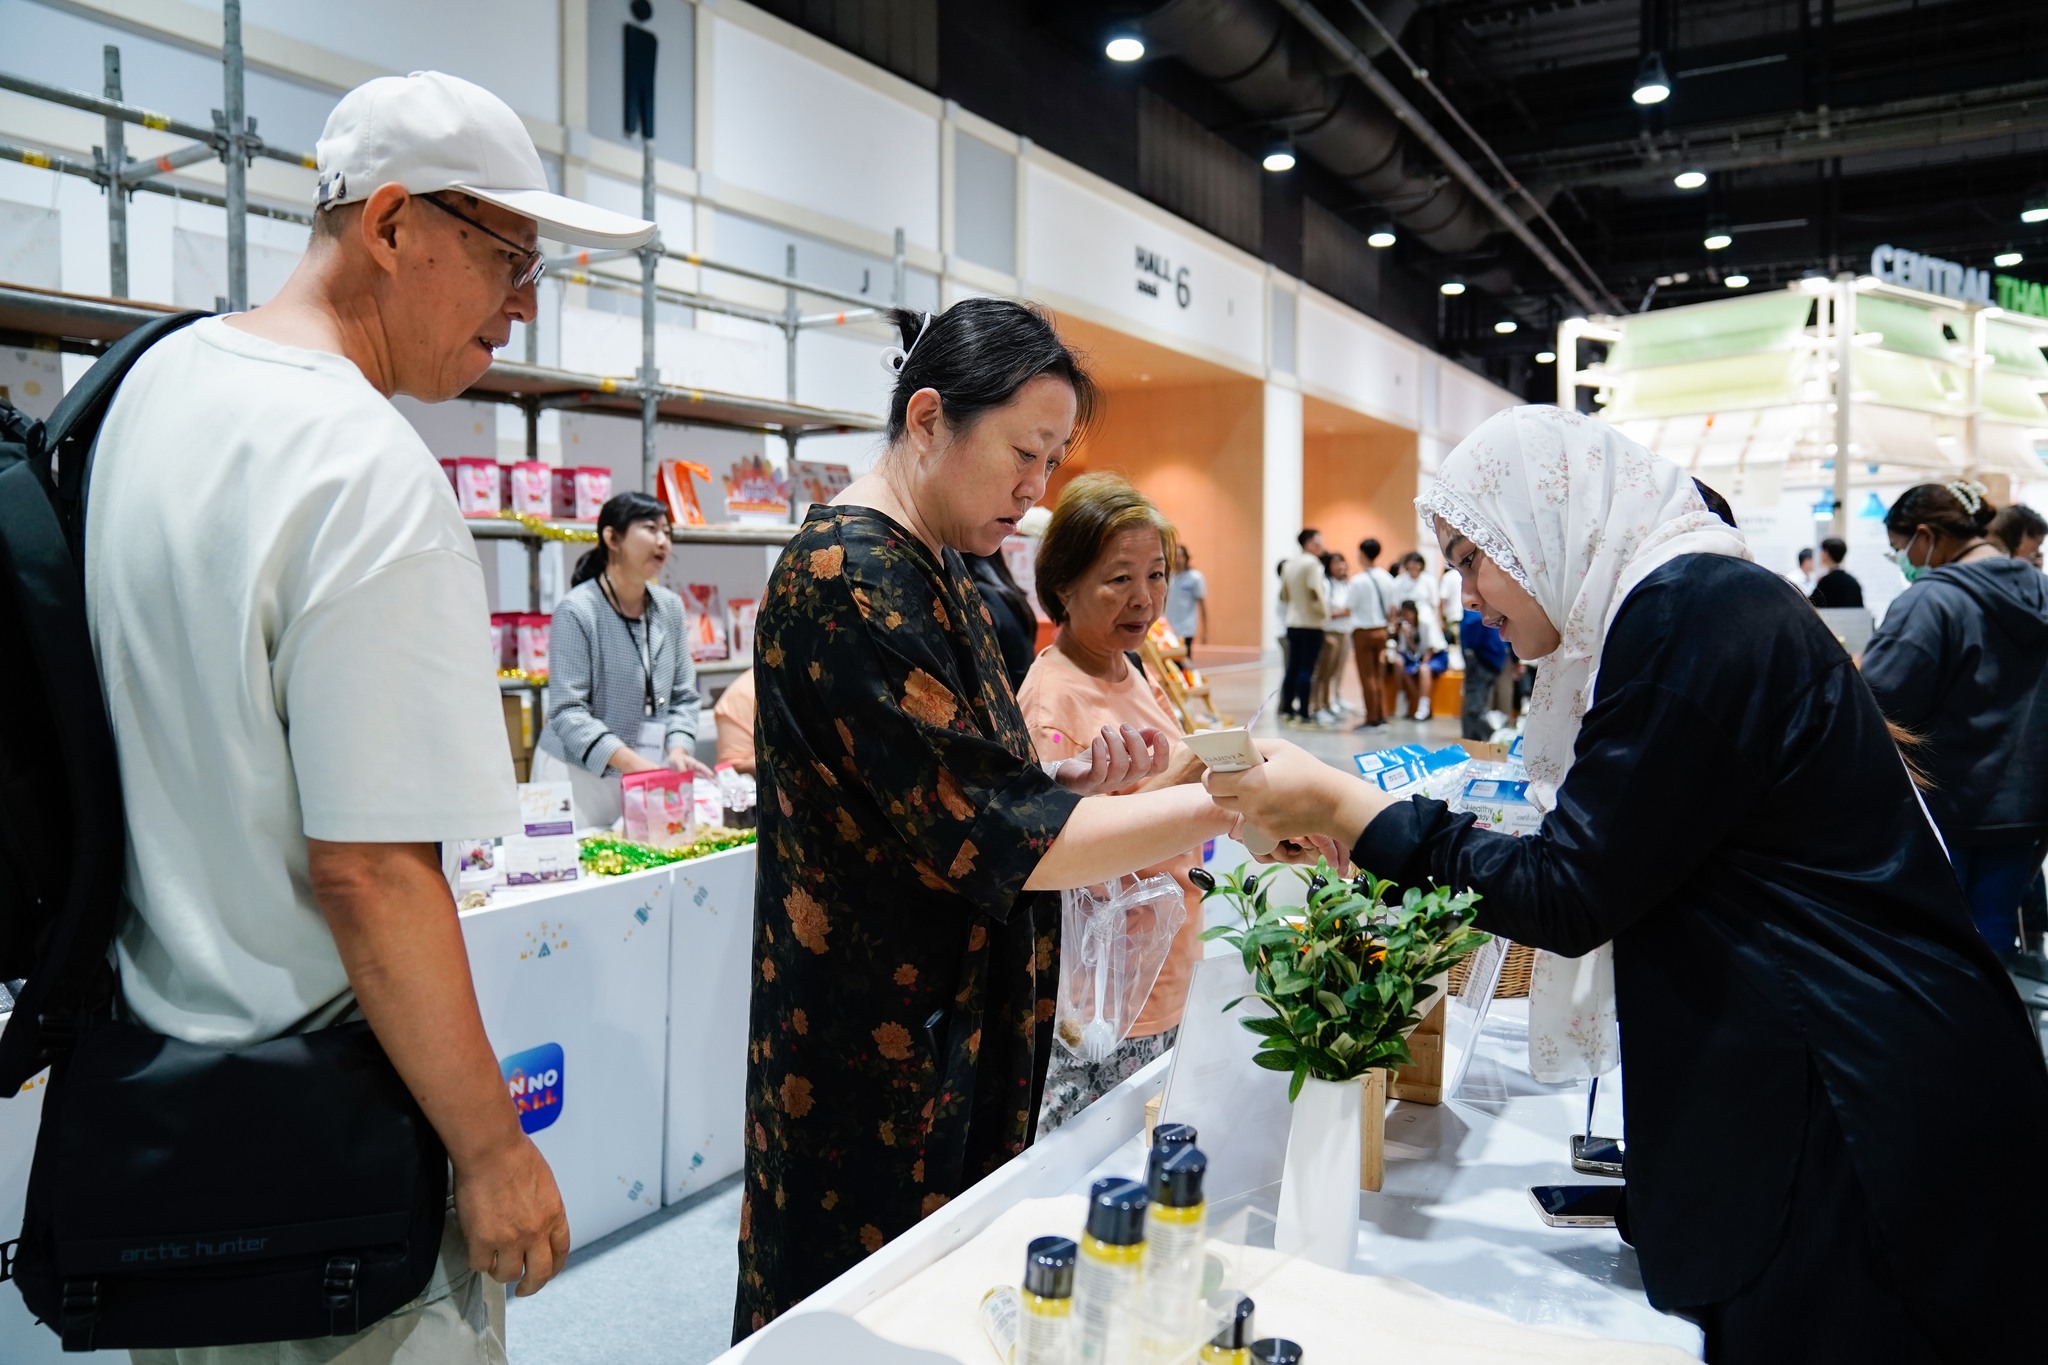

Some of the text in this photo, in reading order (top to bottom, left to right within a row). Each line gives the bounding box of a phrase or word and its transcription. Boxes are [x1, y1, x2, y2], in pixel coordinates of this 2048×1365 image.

[1135, 245, 1171, 282] HALL
[1176, 267, 1191, 309] 6
[1871, 243, 1996, 306] CENTRAL
[120, 1236, 269, 1263] arctic hunter
